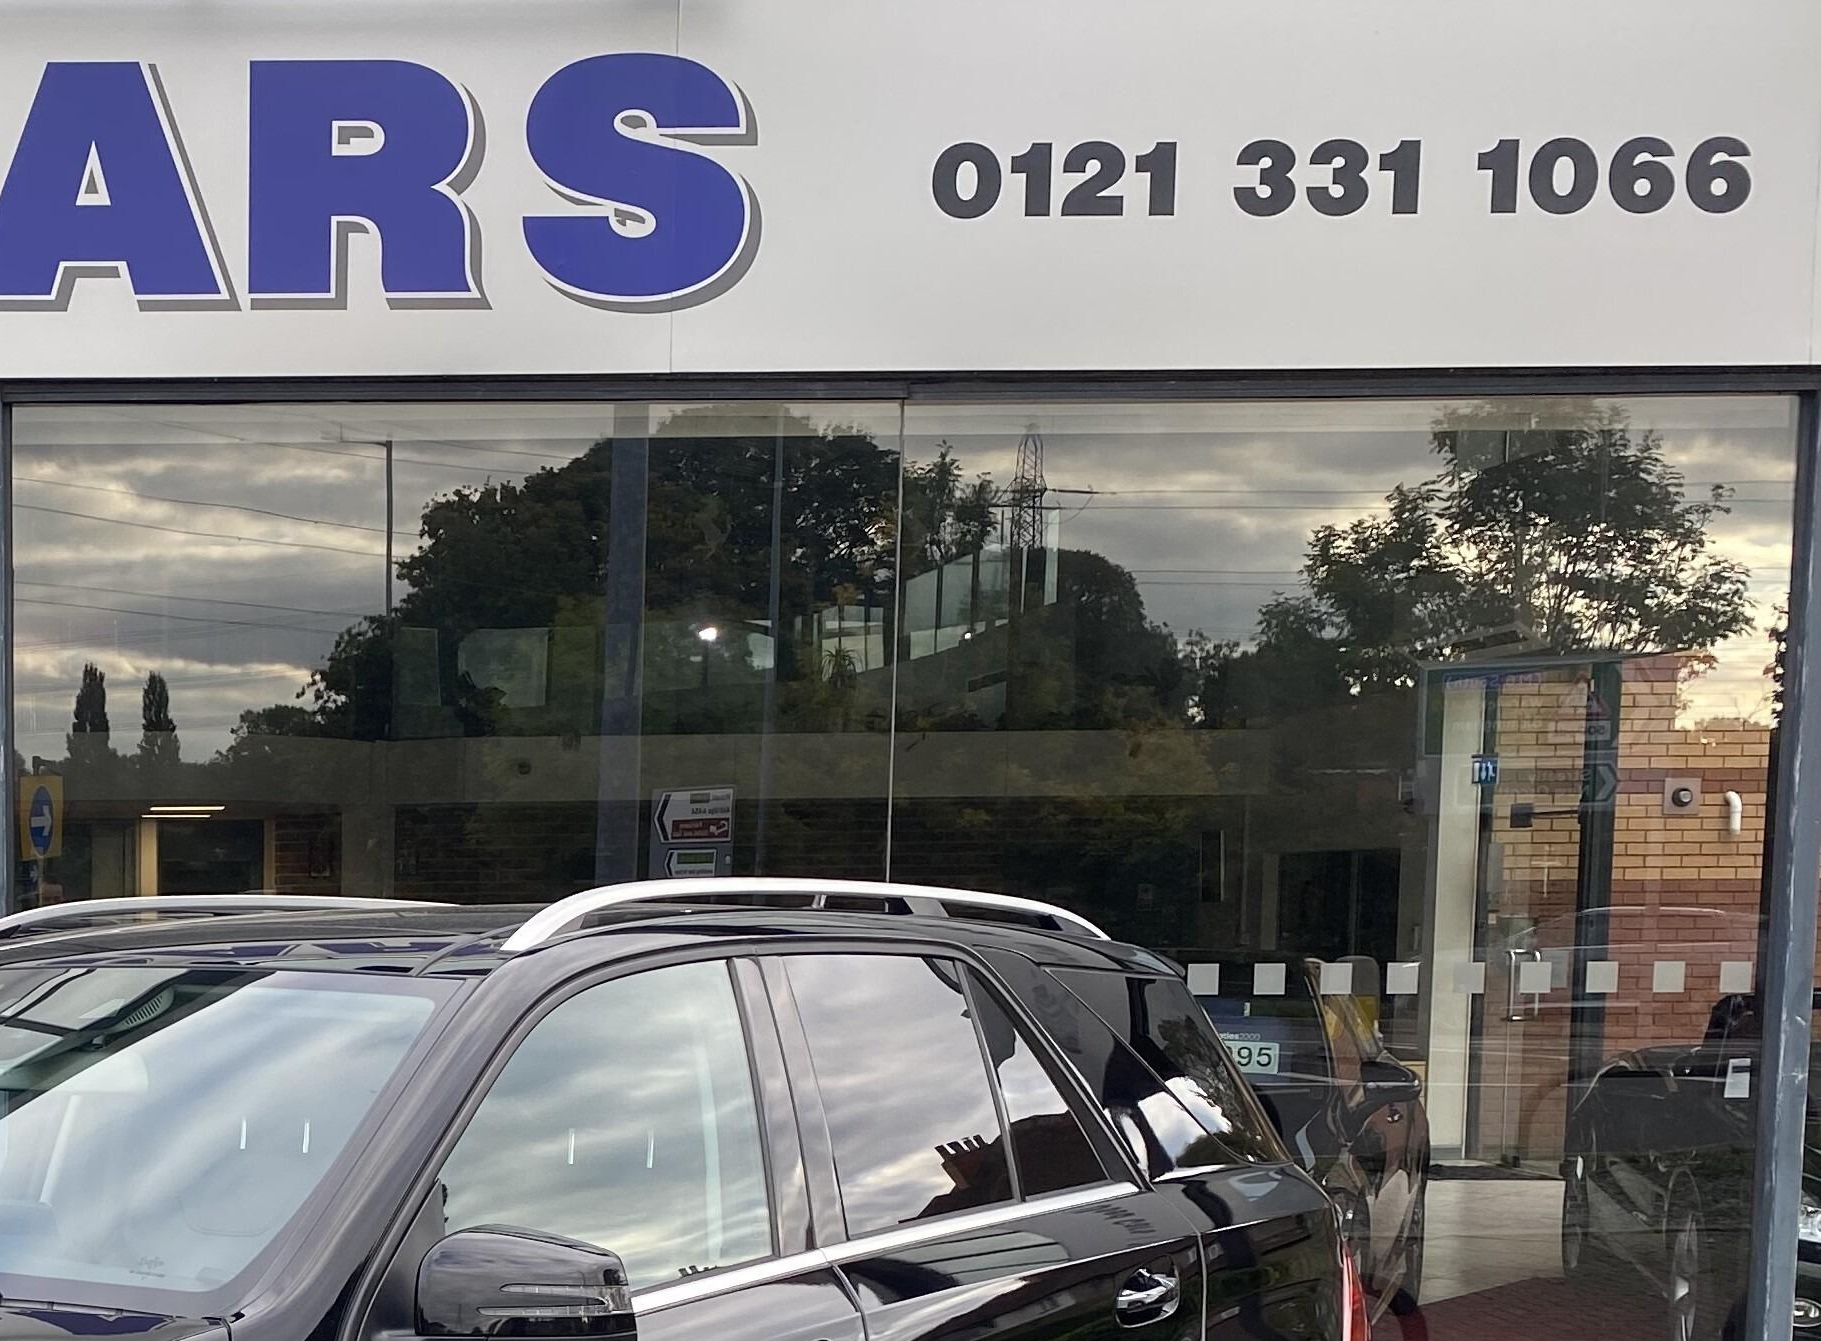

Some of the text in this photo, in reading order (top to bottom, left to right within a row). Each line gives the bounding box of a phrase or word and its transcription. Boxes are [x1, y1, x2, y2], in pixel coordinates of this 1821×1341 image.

[931, 137, 1753, 219] 0121 331 1066
[1225, 1046, 1273, 1067] 95
